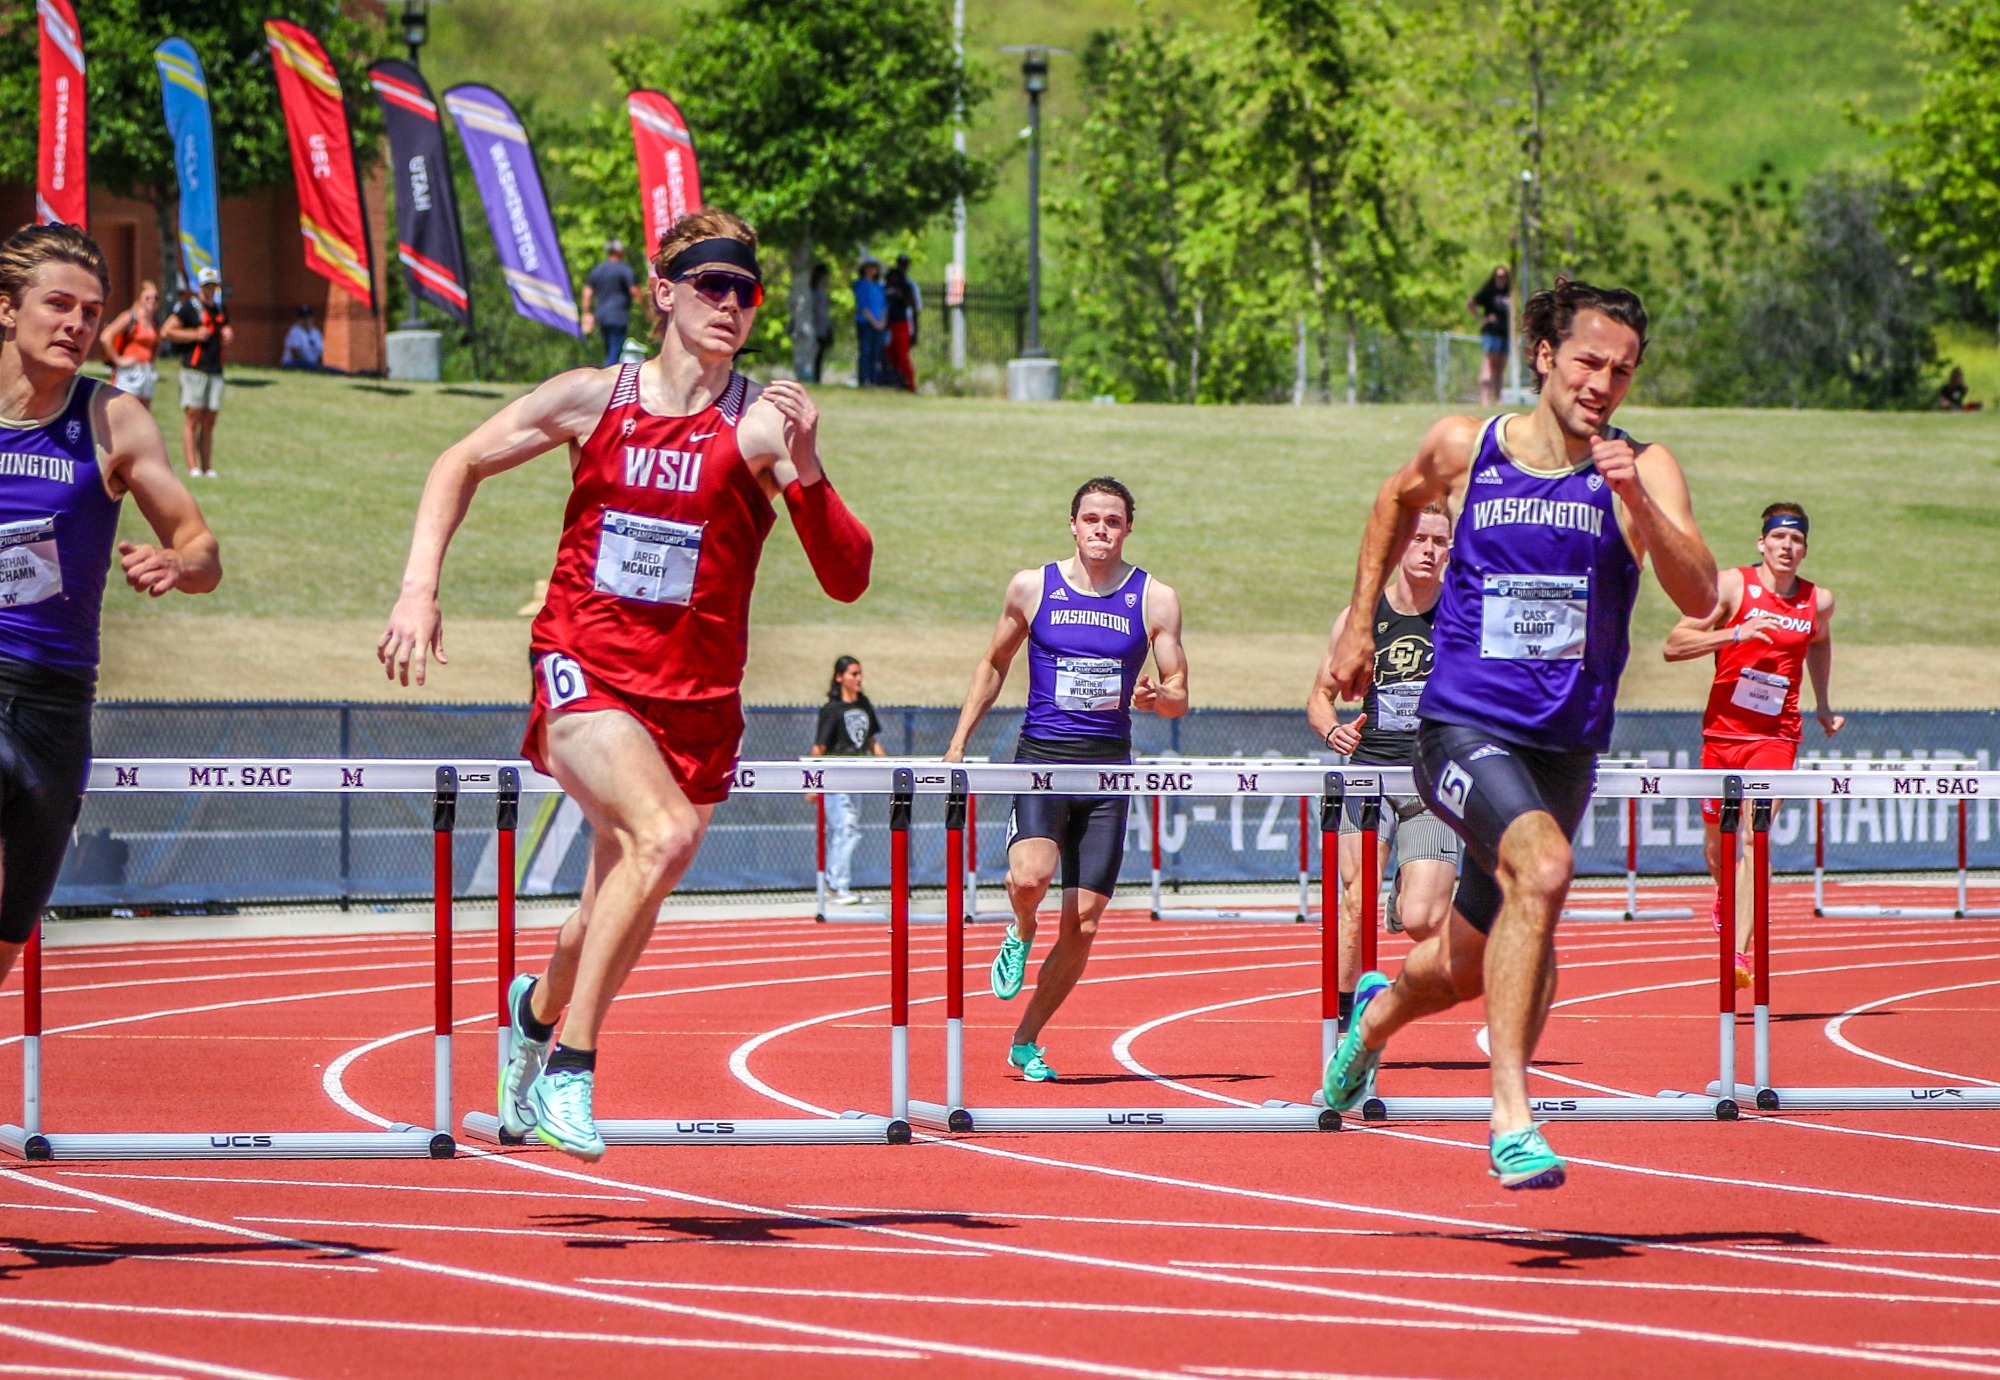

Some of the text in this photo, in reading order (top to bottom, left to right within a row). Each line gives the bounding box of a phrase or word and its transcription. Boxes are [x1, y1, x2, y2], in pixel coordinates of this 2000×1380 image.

[52, 76, 69, 190] STANFORD
[309, 133, 330, 179] USC
[408, 155, 432, 212] UTAH
[489, 140, 540, 273] WASHINGTON
[625, 446, 703, 493] WSU
[1473, 497, 1604, 537] WASHINGTON
[627, 529, 687, 546] CHAMPIONSHIPS
[632, 551, 660, 564] JARED
[621, 560, 668, 578] MCALVEY
[1050, 609, 1131, 635] WASHINGTON
[1522, 610, 1547, 621] CASS
[1514, 622, 1555, 634] ELLIOTT
[552, 655, 575, 699] 6
[1075, 680, 1103, 688] MATTHEW
[1070, 687, 1107, 696] WILKINSON
[189, 766, 234, 787] MT.
[241, 766, 292, 787] SAC
[458, 774, 492, 782] UCS
[915, 776, 946, 784] UCS
[1098, 772, 1140, 791] MT.
[1146, 772, 1193, 791] SAC
[1344, 779, 1374, 787] UCS
[1442, 769, 1464, 806] 5
[1893, 778, 1931, 795] MT.
[1936, 778, 1980, 795] SAC
[1107, 1113, 1166, 1125] UCS
[676, 1122, 736, 1134] UCS
[210, 1135, 273, 1148] UCS
